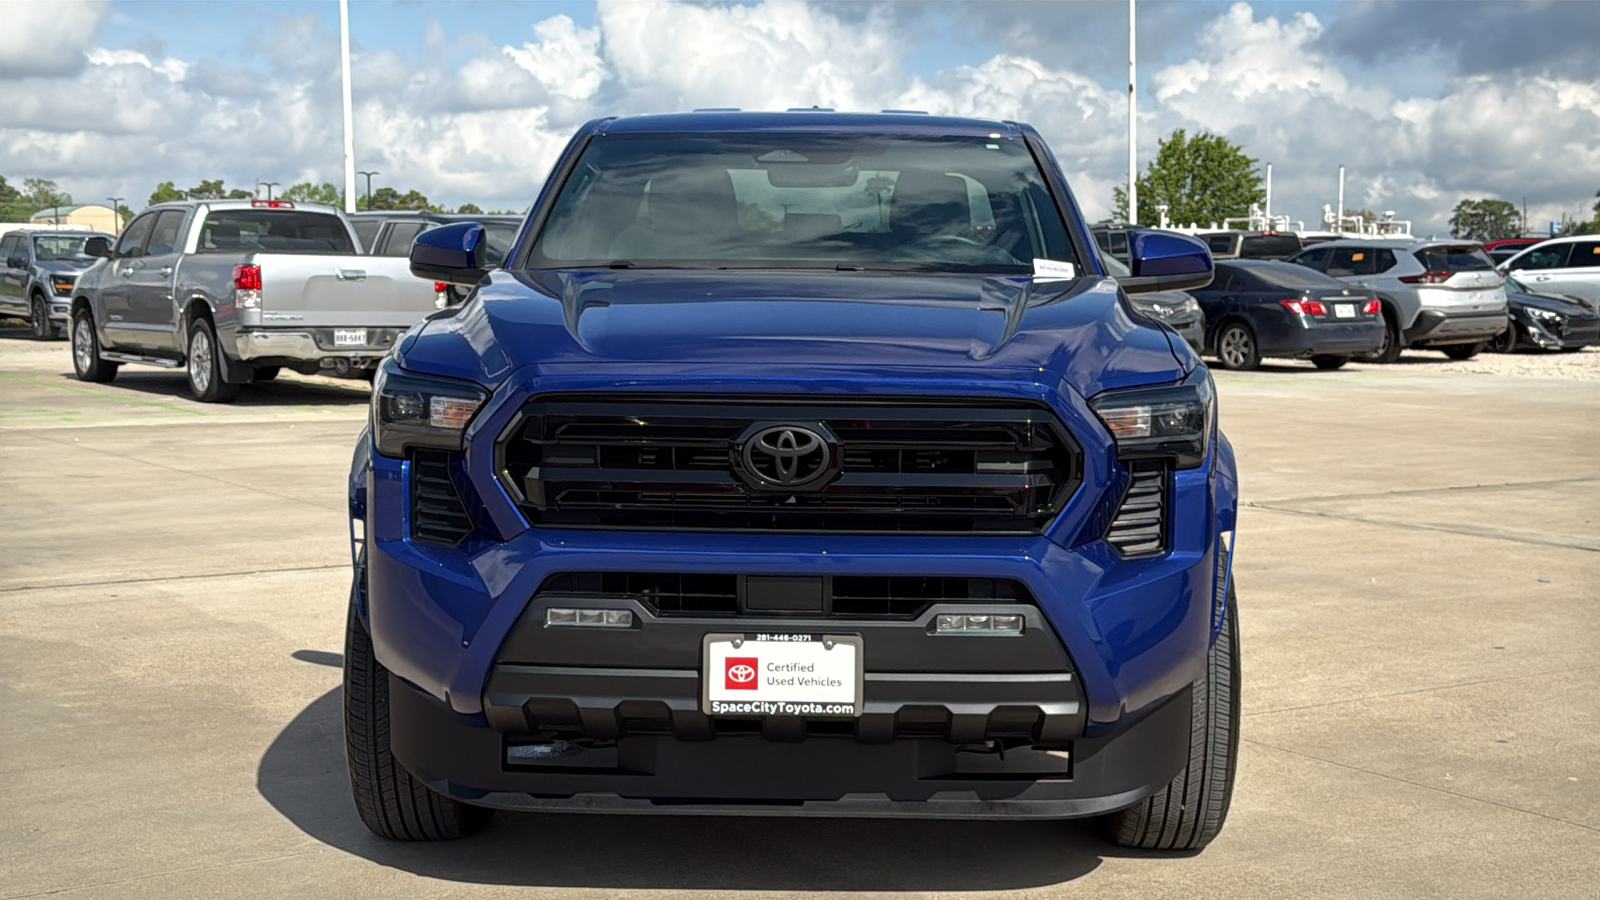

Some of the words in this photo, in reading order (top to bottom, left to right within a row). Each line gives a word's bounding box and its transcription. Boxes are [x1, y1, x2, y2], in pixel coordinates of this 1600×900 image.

[756, 633, 811, 641] 281-446-0271
[767, 662, 814, 672] Certified
[767, 676, 794, 686] Used
[797, 677, 842, 687] Vehicles
[712, 701, 854, 715] SpaceCityToyota.com
